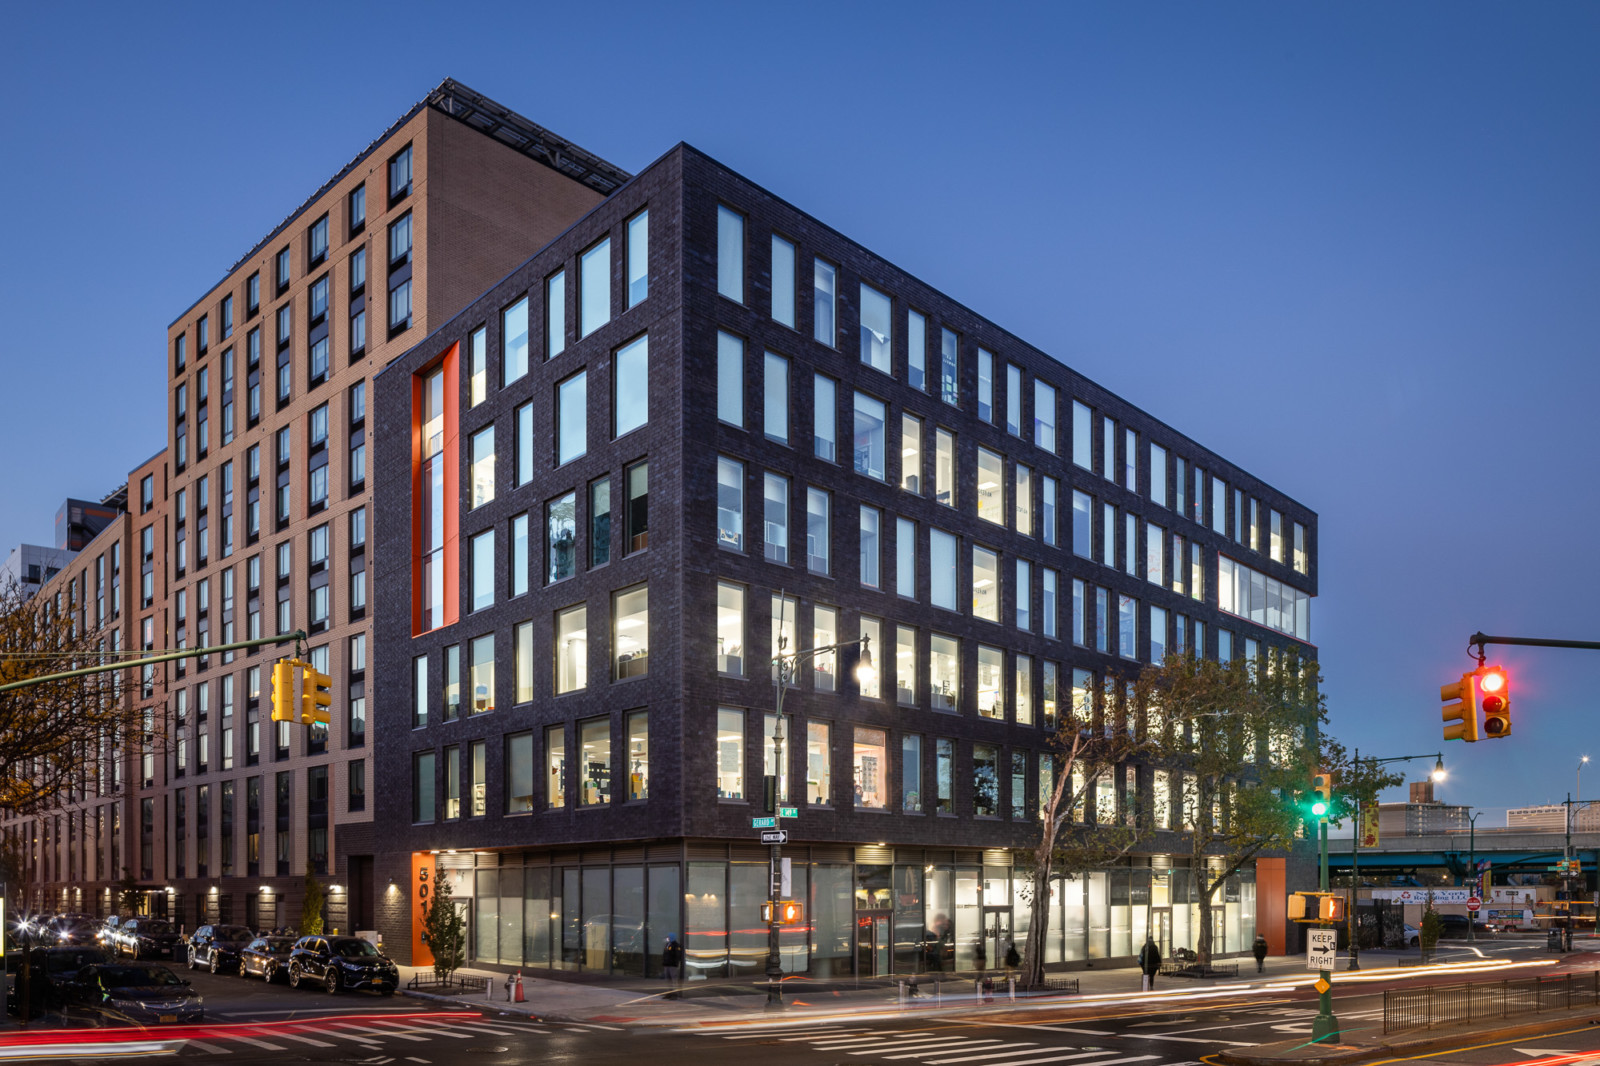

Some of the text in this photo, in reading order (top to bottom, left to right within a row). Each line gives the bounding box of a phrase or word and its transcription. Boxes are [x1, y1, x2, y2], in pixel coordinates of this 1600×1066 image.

[753, 818, 770, 826] GERARD
[420, 867, 428, 915] 501
[1312, 934, 1332, 943] KEEP
[1310, 956, 1333, 965] RIGHT
